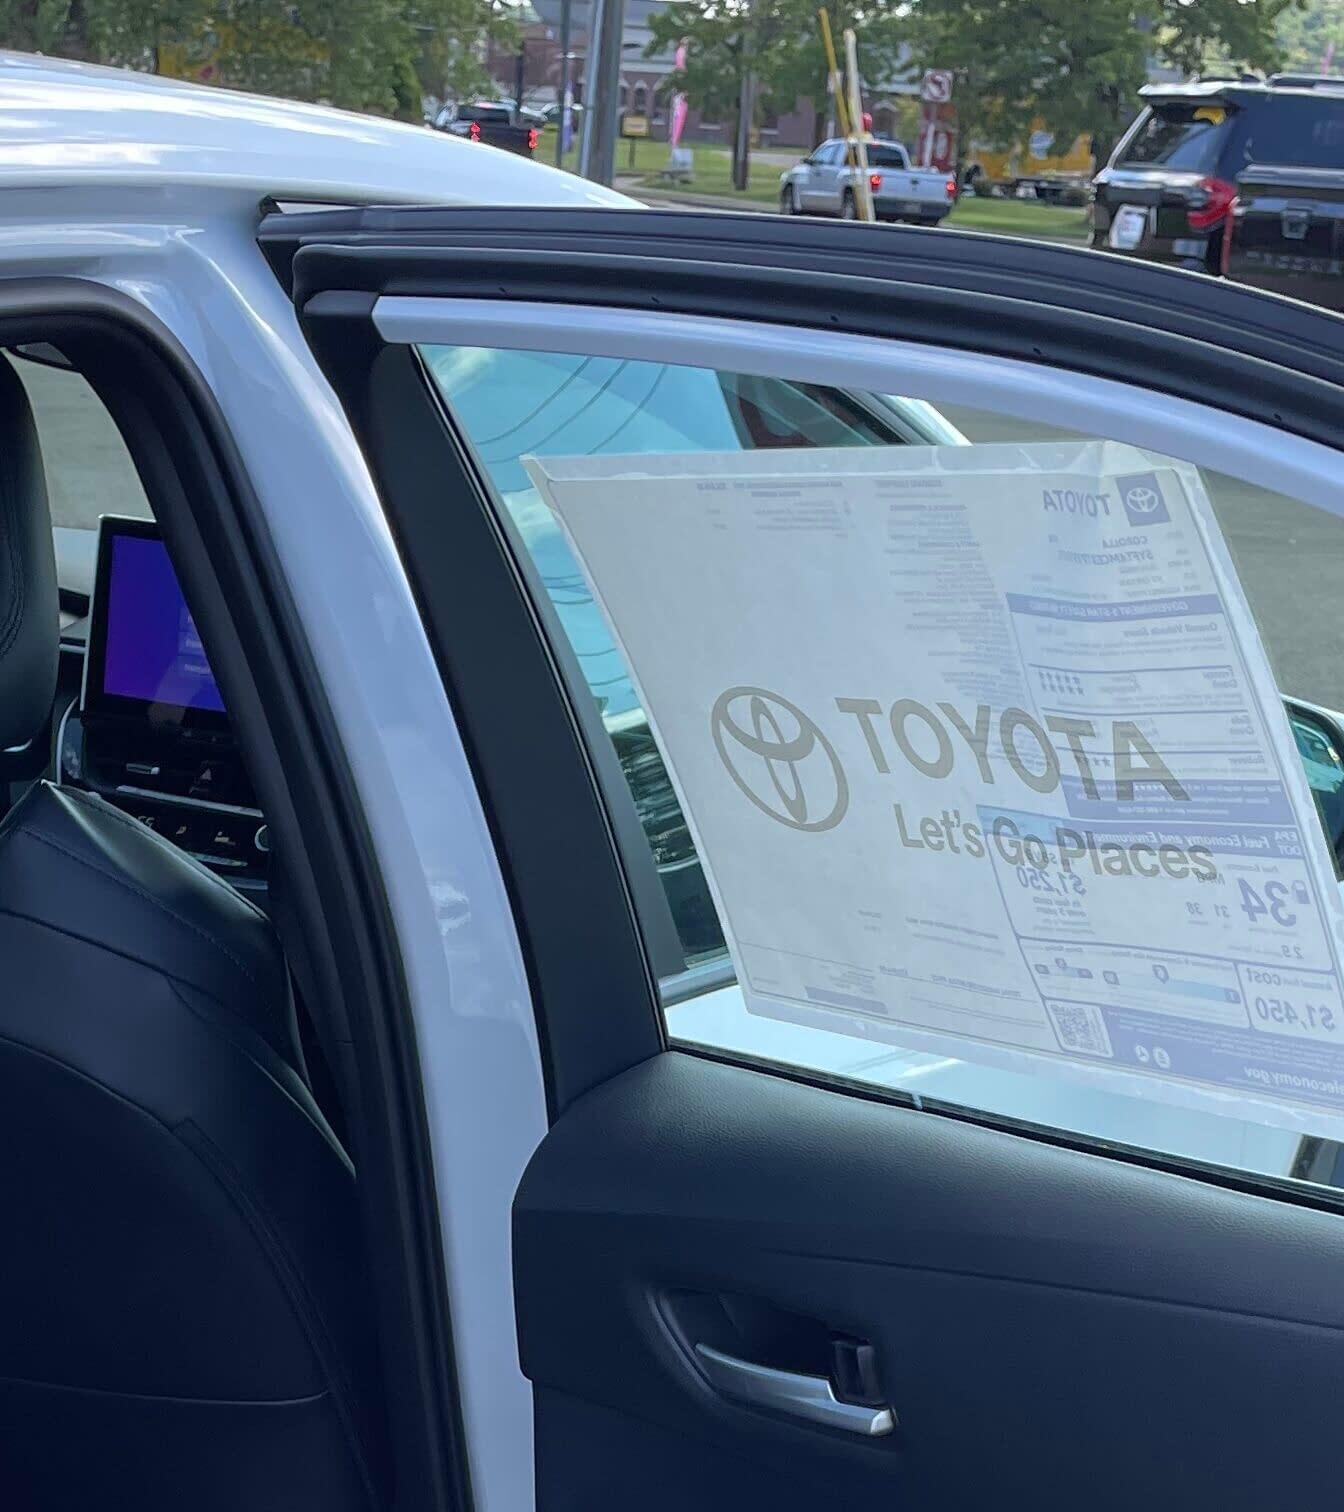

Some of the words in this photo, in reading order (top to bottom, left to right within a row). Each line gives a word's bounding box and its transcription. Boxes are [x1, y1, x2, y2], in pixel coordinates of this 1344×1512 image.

[834, 696, 1192, 801] TOYOTA
[893, 803, 985, 858] Let's
[993, 815, 1052, 871] Go
[1056, 826, 1217, 880] Places
